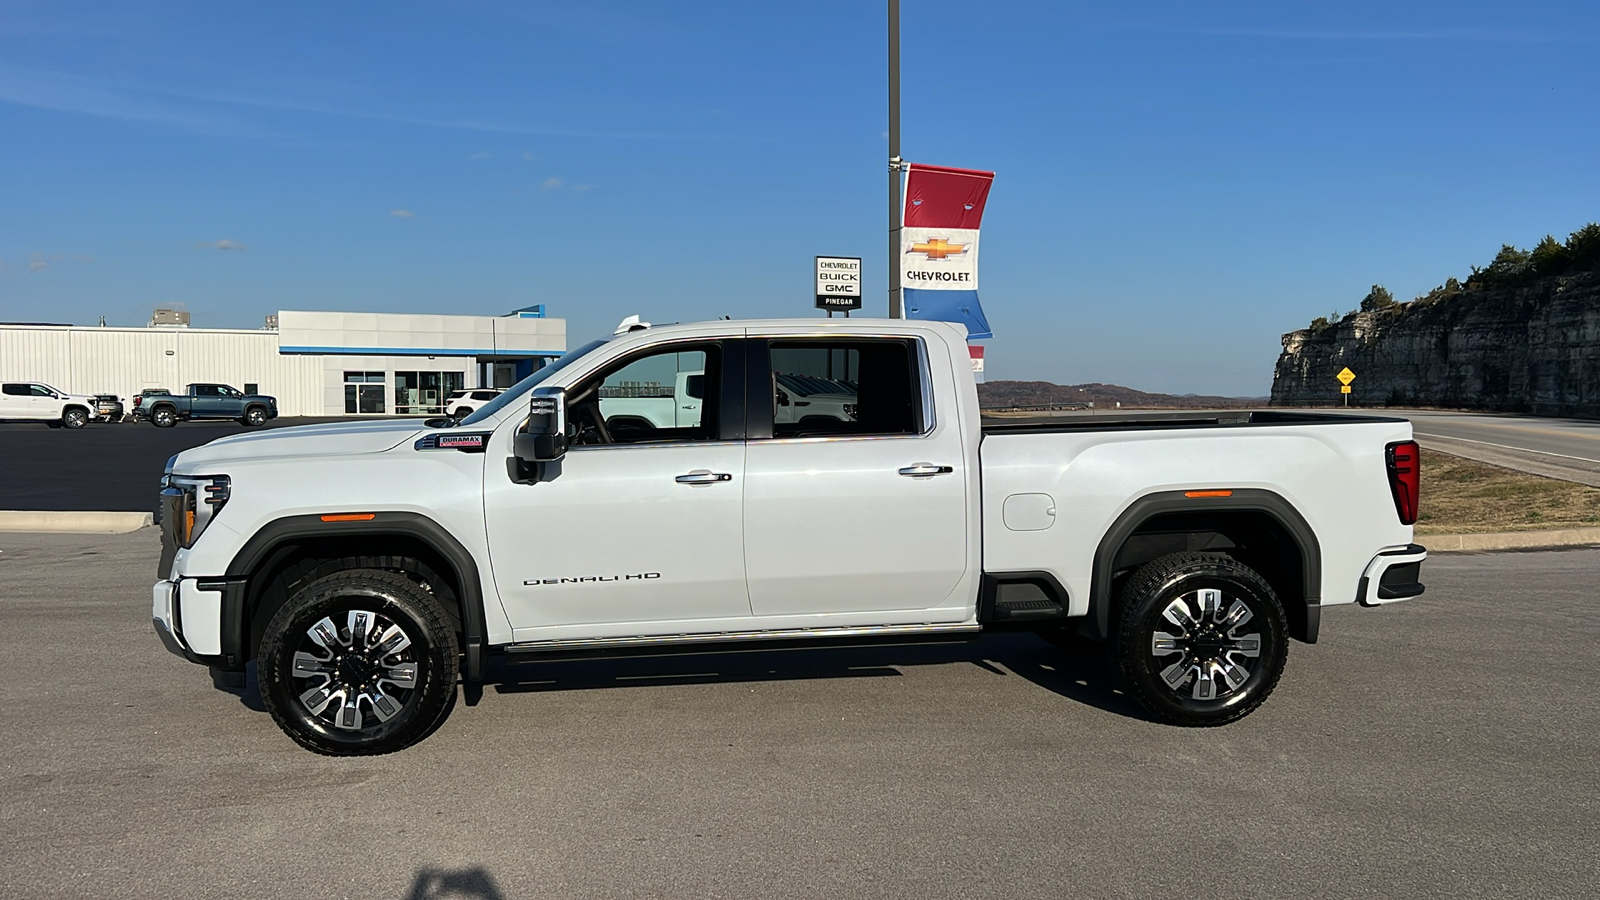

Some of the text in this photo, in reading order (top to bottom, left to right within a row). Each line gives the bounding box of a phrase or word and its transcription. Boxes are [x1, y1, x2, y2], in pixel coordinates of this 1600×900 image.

[820, 261, 858, 270] CHEVROLET
[819, 273, 858, 281] BUICK
[906, 270, 970, 282] CHEVROLET
[825, 284, 853, 293] GMC
[825, 297, 853, 305] PINEGAR
[523, 572, 661, 586] DENALI HD
